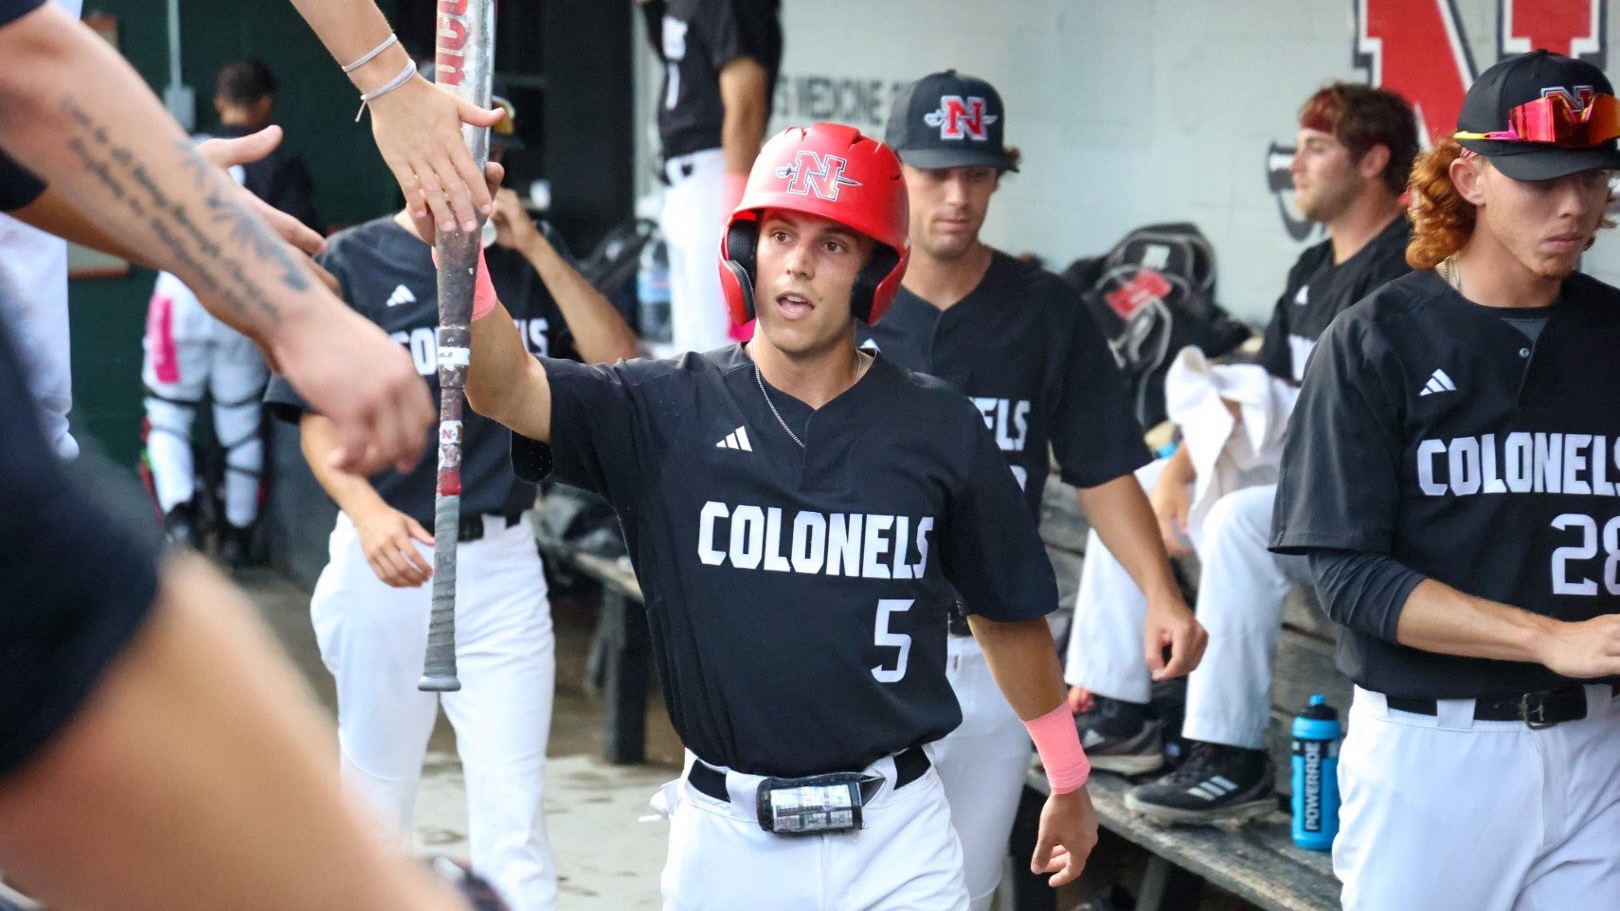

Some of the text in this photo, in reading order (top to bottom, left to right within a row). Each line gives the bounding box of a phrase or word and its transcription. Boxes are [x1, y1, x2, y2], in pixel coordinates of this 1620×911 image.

[941, 95, 988, 141] N
[787, 151, 848, 202] N
[1417, 432, 1620, 497] COLONEL
[698, 500, 934, 579] COLONELS
[870, 598, 916, 683] 5
[1305, 742, 1320, 831] POWERADE
